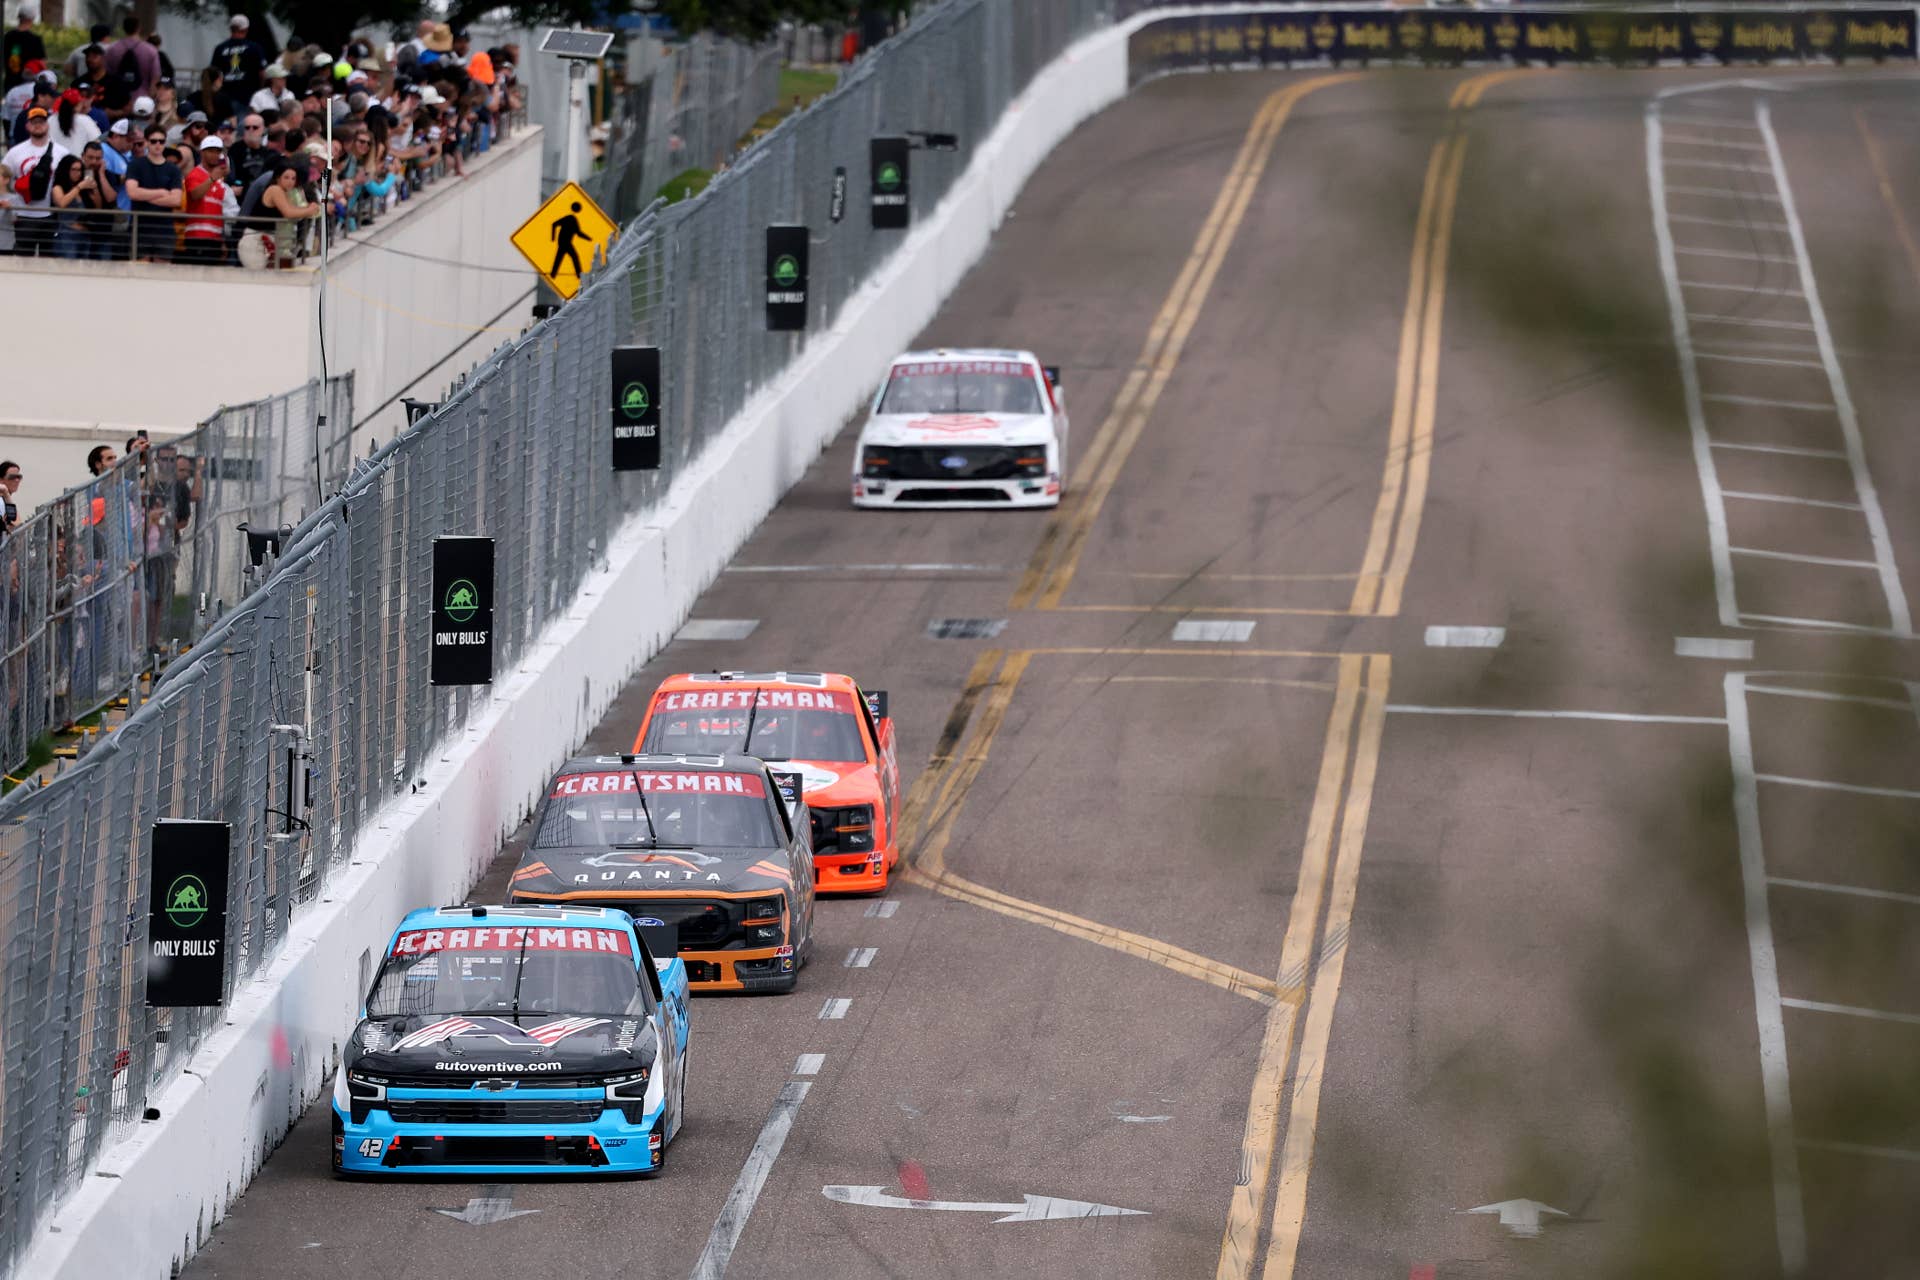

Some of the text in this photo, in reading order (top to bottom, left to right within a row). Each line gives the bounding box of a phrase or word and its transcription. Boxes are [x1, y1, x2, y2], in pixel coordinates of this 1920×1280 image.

[615, 425, 656, 438] ONLY BULLS
[436, 631, 486, 645] ONLY BULLS
[666, 691, 835, 710] CRAFTSMAN
[564, 775, 744, 795] CRAFTSMAN
[574, 870, 721, 883] QUANTA
[153, 939, 216, 957] ONLY BULLS
[402, 928, 619, 952] CRAFTSMAN
[435, 1061, 562, 1072] autoventive.com
[358, 1138, 383, 1157] 42
